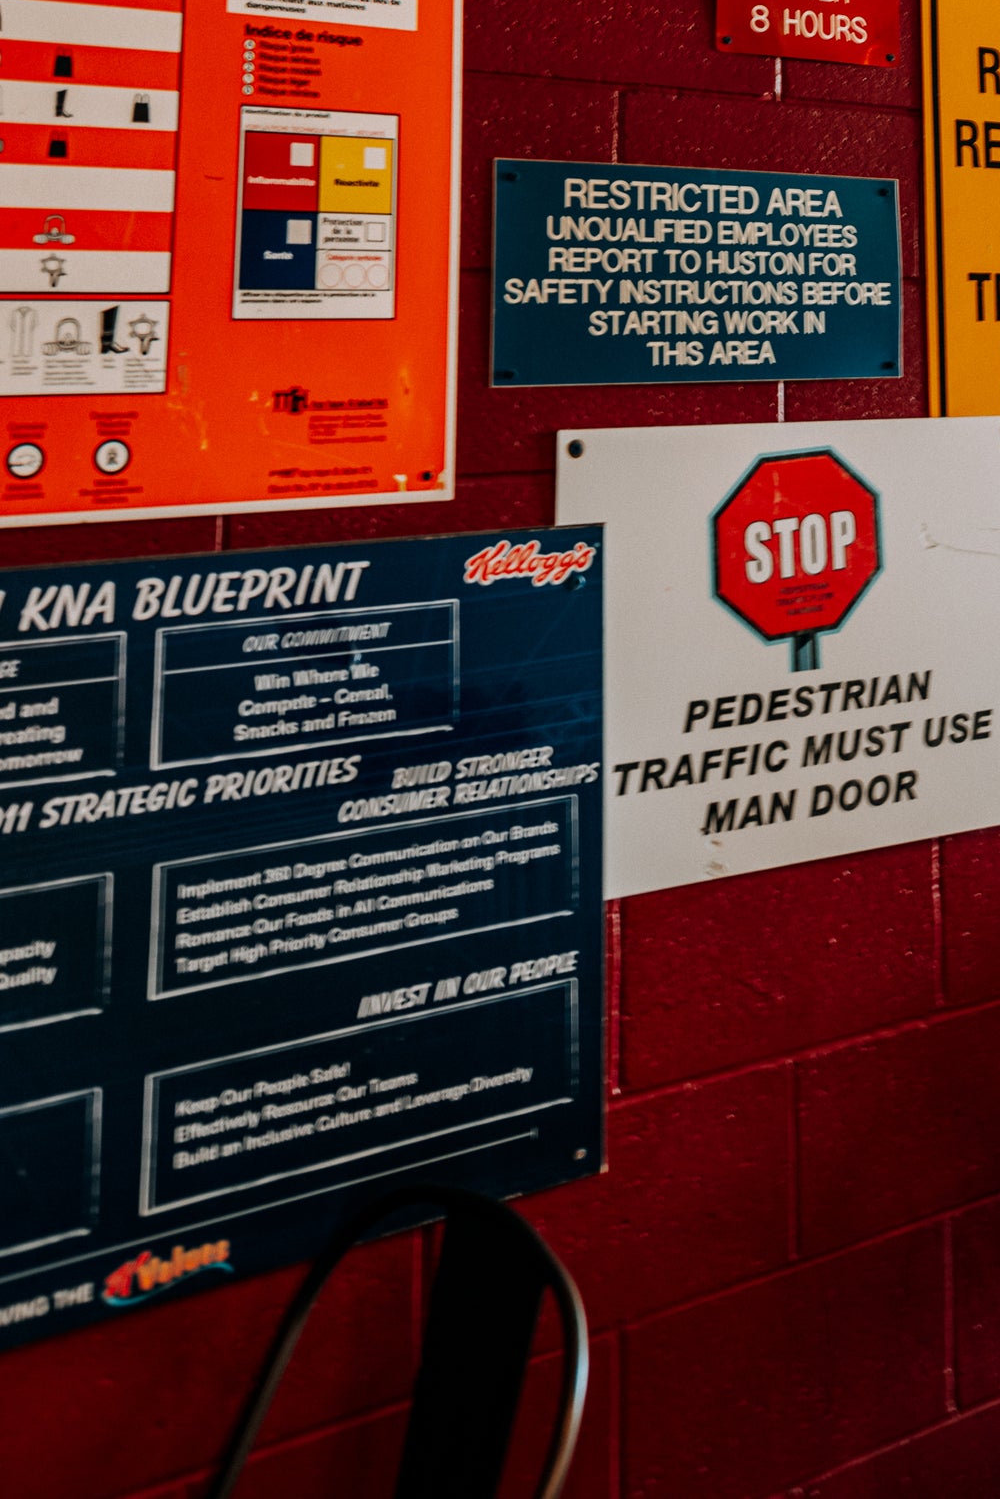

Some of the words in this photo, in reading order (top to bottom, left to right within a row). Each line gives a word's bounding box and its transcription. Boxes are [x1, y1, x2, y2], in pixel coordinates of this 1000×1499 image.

[749, 4, 770, 33] 8
[782, 8, 868, 45] HOURS
[564, 177, 760, 216] RESTRICTED
[766, 186, 844, 219] AREA
[546, 215, 713, 245] UNQUALIFIED
[717, 220, 858, 249] EMPLOYEES
[548, 247, 658, 275] REPORT
[663, 249, 701, 275] TO
[706, 250, 805, 276] HUSTON
[808, 251, 857, 278] FOR
[504, 278, 614, 305] SAFETY
[619, 279, 798, 306] INSTRUCTIONS
[802, 281, 892, 306] BEFORE
[588, 310, 719, 337] STARTING
[724, 310, 800, 335] WORK
[804, 311, 826, 335] IN
[646, 341, 704, 367] THIS
[708, 340, 777, 366] AREA
[464, 540, 596, 587] Kellogg's
[743, 510, 856, 585] STOP
[18, 581, 116, 632] KNA
[132, 561, 371, 621] BLUEPRINT
[242, 633, 280, 653] OUR
[281, 622, 392, 649] COMMITMENT
[683, 669, 932, 734] PEDESTRIAN
[233, 720, 299, 742] Snacks
[301, 713, 335, 733] and
[391, 761, 452, 789] BUILD
[455, 746, 554, 779] STRONGER
[613, 740, 789, 797] TRAFFIC
[801, 722, 912, 769] MUST
[923, 709, 993, 748] USE
[39, 778, 198, 828] STRATEGIC
[203, 755, 362, 804] PRIORITIES
[338, 786, 450, 823] CONSUMER
[453, 762, 601, 805] RELATIONSHIPS
[702, 788, 797, 836] MAN
[809, 770, 919, 818] DOOR
[177, 872, 262, 899] Implement
[350, 838, 459, 868] Communication
[481, 830, 508, 845] Our
[510, 821, 559, 840] Brands
[176, 898, 252, 925] Establish
[252, 885, 332, 910] Consumer
[333, 868, 424, 895] Relationship
[496, 844, 561, 864] Programs
[376, 879, 494, 910] Communications
[174, 951, 228, 974] Target
[230, 943, 269, 964] High
[269, 933, 327, 955] Priority
[327, 916, 404, 943] Consumer
[404, 908, 459, 929] Groups
[357, 982, 433, 1019] INVEST
[433, 976, 462, 1001] IN
[462, 967, 507, 994] OUR
[508, 950, 580, 984] PEOPLE
